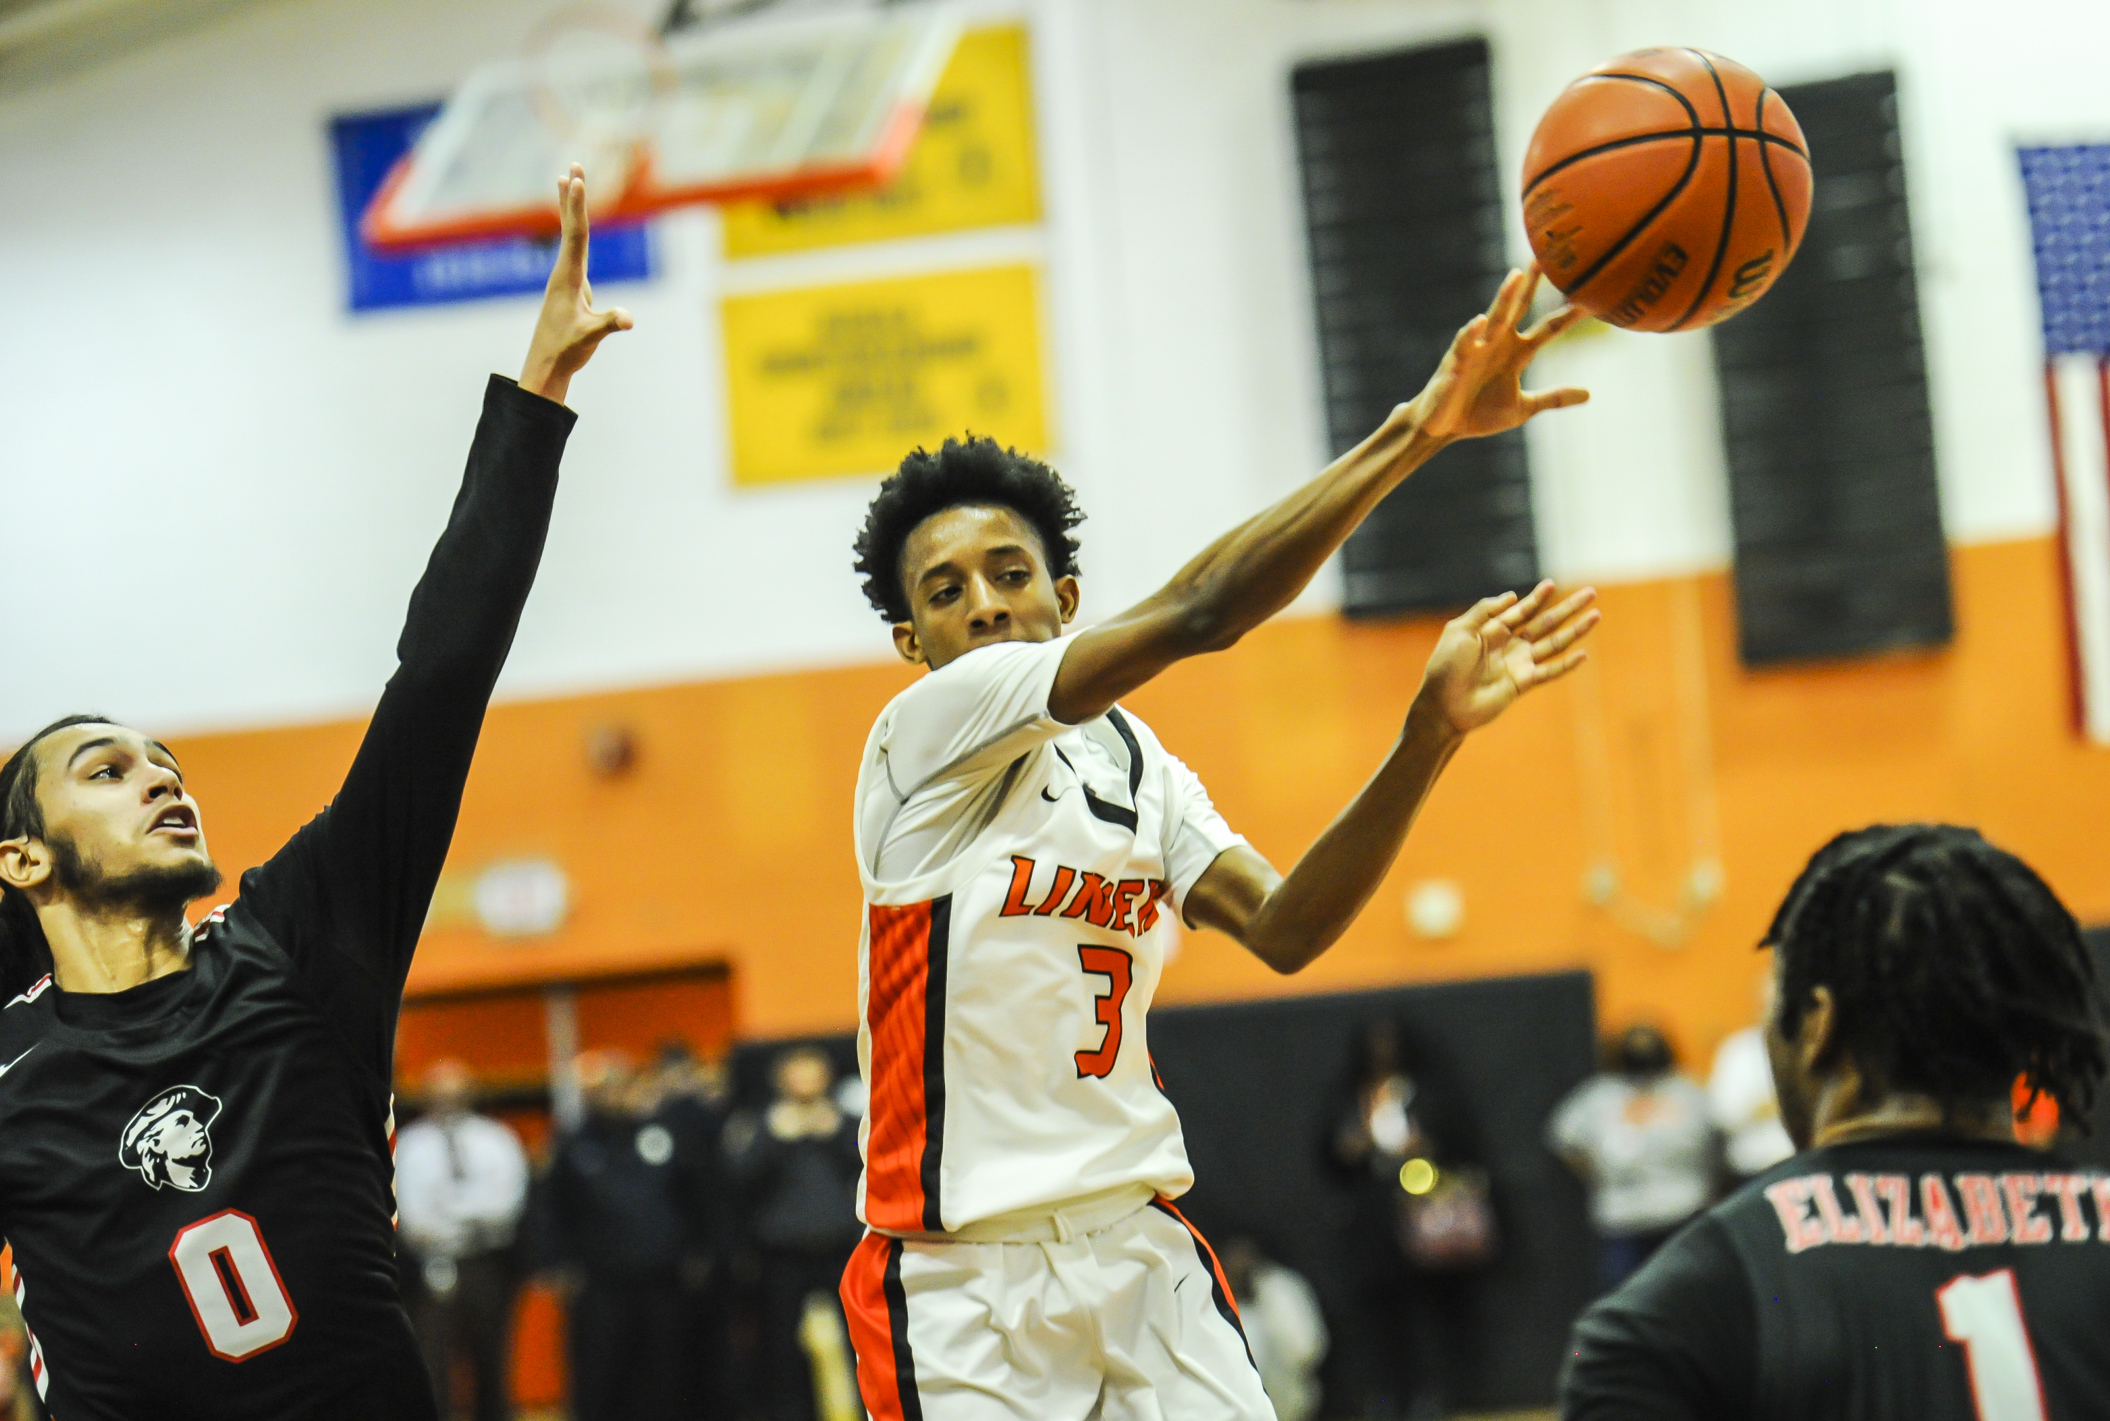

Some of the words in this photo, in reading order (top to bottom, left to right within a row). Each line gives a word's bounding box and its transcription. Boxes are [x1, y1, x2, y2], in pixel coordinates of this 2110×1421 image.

[1074, 944, 1134, 1080] 3
[168, 1207, 299, 1364] 0
[1935, 1266, 2049, 1421] 1
